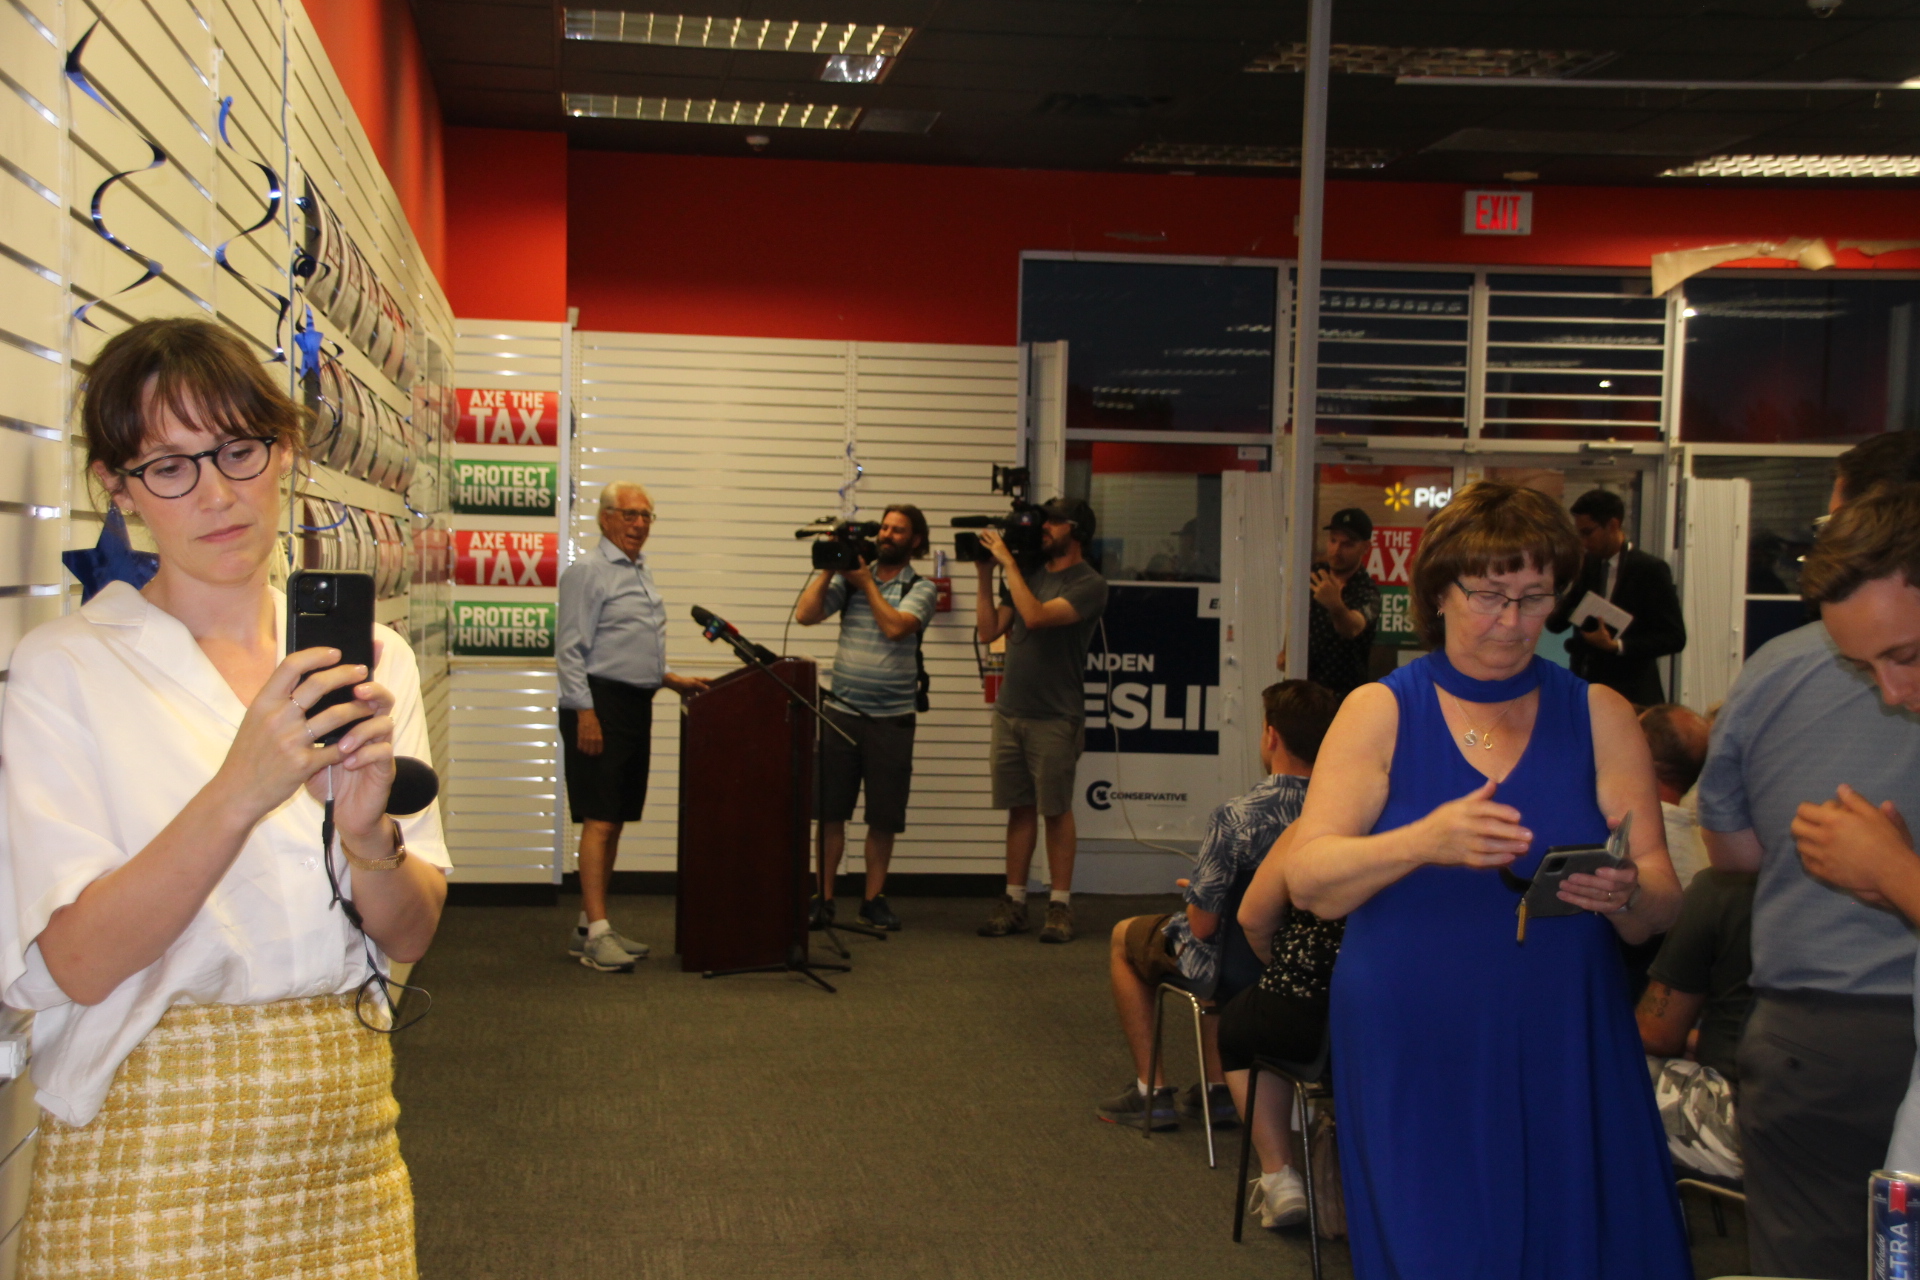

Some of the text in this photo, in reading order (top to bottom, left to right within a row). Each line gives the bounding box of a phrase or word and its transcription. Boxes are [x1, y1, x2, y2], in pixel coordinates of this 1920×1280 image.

[1476, 195, 1522, 230] EXIT
[469, 390, 545, 409] AXE THE
[468, 407, 543, 445] TAX
[459, 464, 550, 487] PROTECT
[459, 485, 551, 508] HUNTERS
[469, 532, 545, 550] AXE THE
[1382, 531, 1412, 547] THE
[468, 549, 543, 585] TAX
[1366, 548, 1411, 581] AX
[459, 606, 549, 628] PROTECT
[1379, 614, 1414, 632] ERS
[458, 627, 550, 649] HUNTERS
[1084, 653, 1155, 672] NDEN
[1110, 792, 1188, 802] CONSERVATIVE
